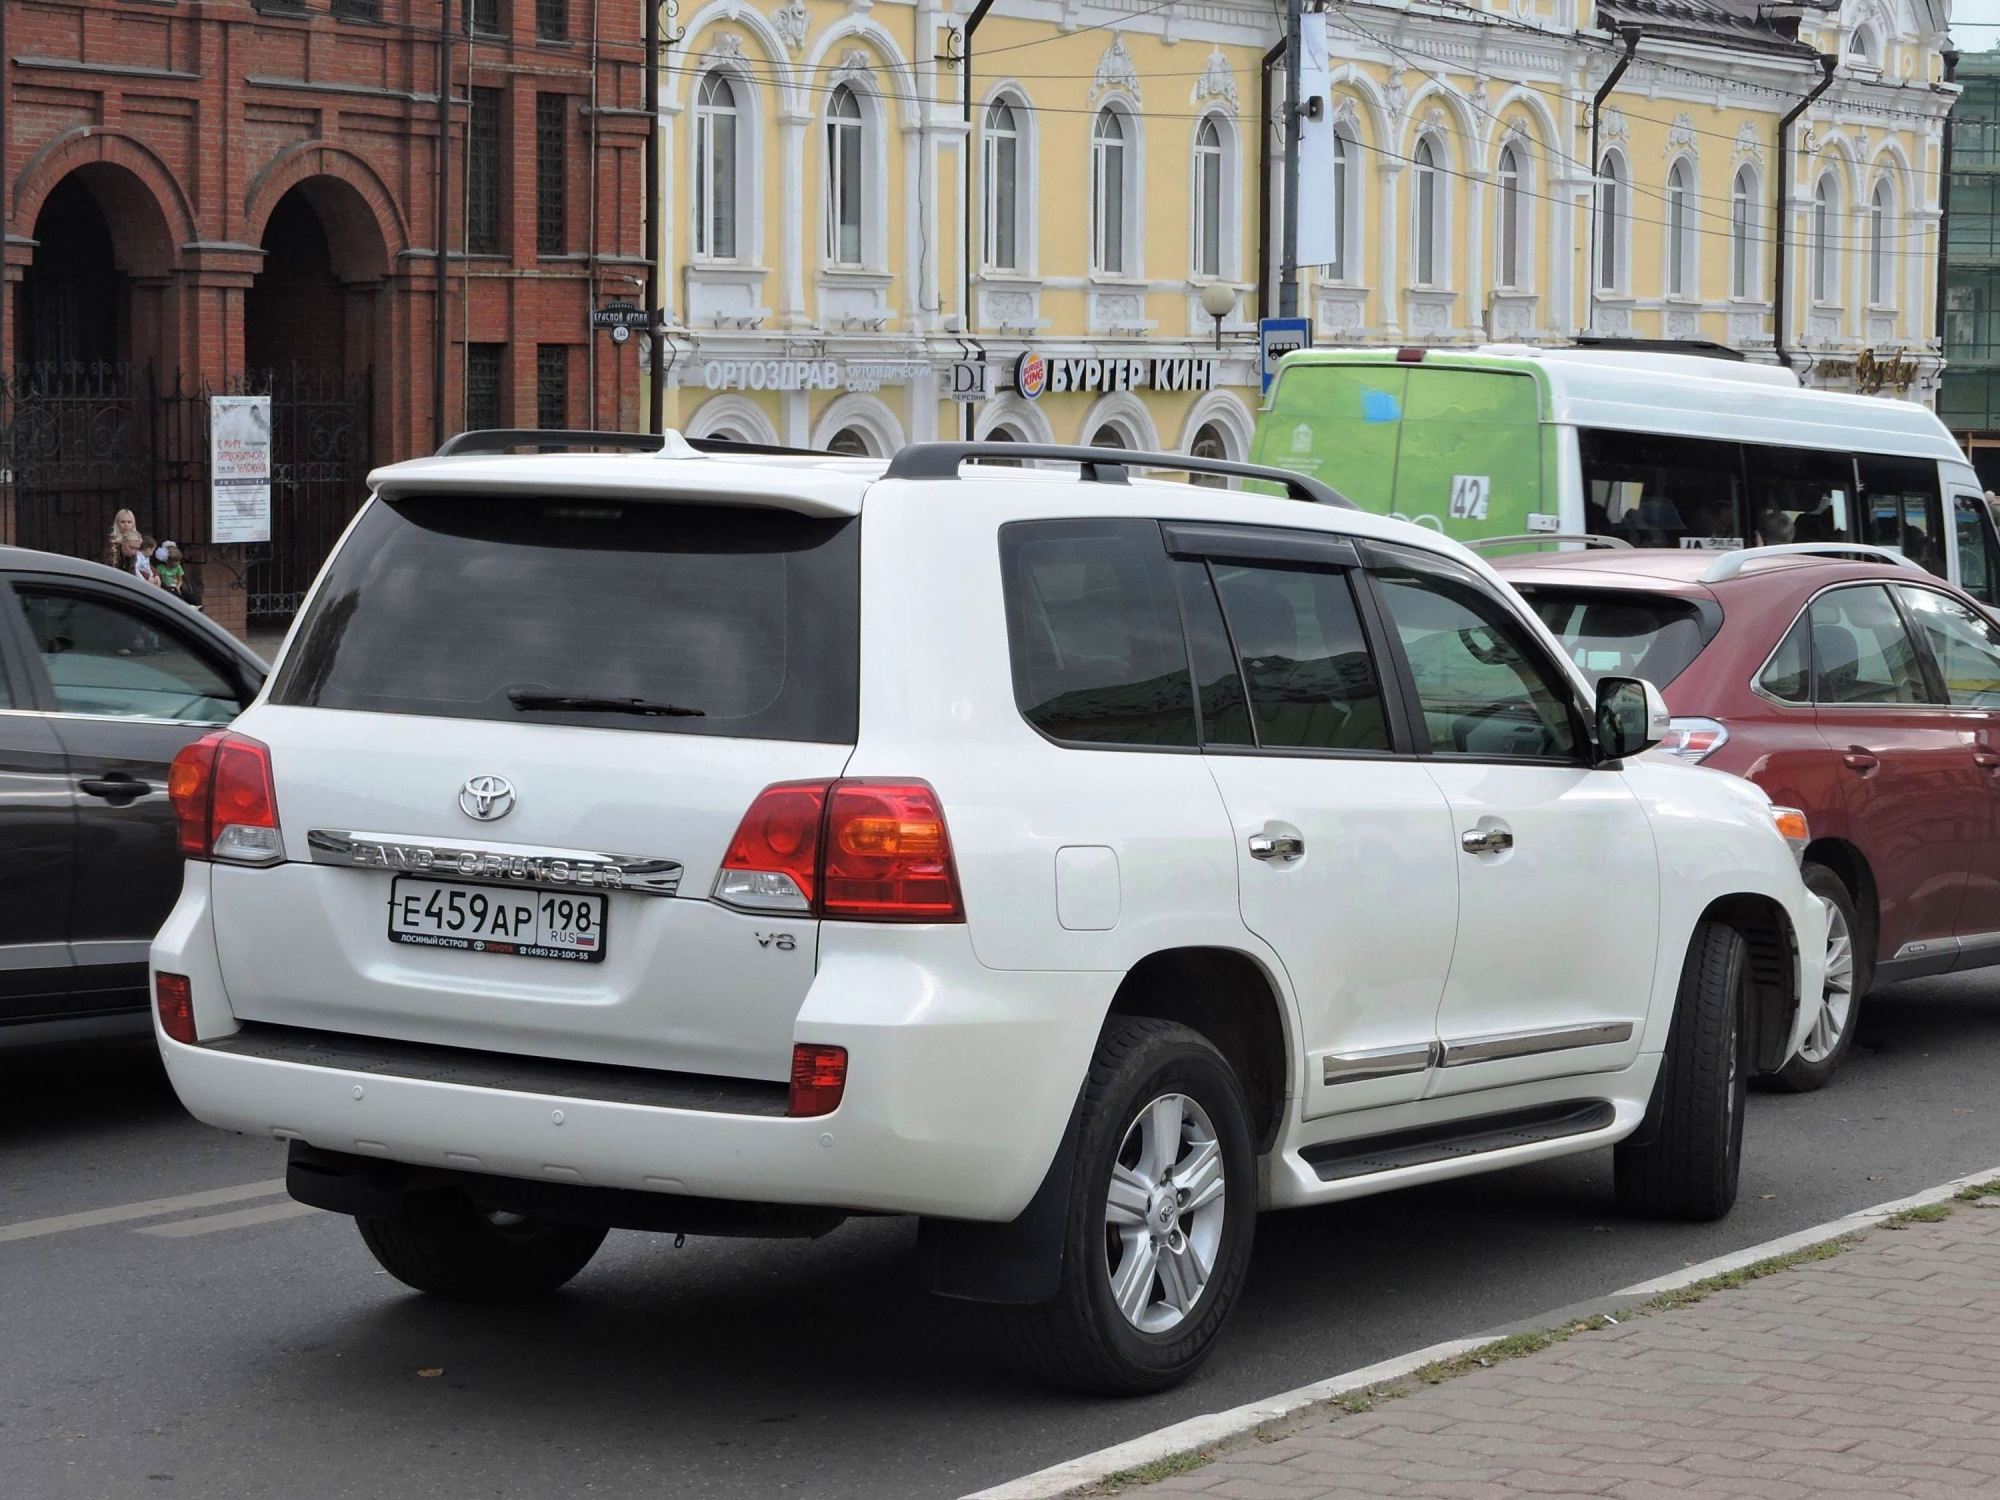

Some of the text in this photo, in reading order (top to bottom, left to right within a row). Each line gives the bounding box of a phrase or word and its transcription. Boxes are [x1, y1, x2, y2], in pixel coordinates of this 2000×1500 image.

[704, 360, 838, 391] ОРТОЗДРАВ
[1023, 360, 1043, 374] BURGER
[1051, 359, 1221, 392] БУРГЕР КИНГ
[847, 379, 880, 392] САЛОН
[1023, 368, 1044, 386] KING
[1453, 478, 1481, 519] 42
[351, 843, 623, 889] LAND CRUISER
[541, 898, 592, 932] 198
[438, 938, 469, 948] ОСТРОВ
[551, 930, 576, 944] RUS
[754, 932, 796, 951] V8
[486, 943, 514, 953] TOYOTA
[549, 950, 589, 960] 22-100-55
